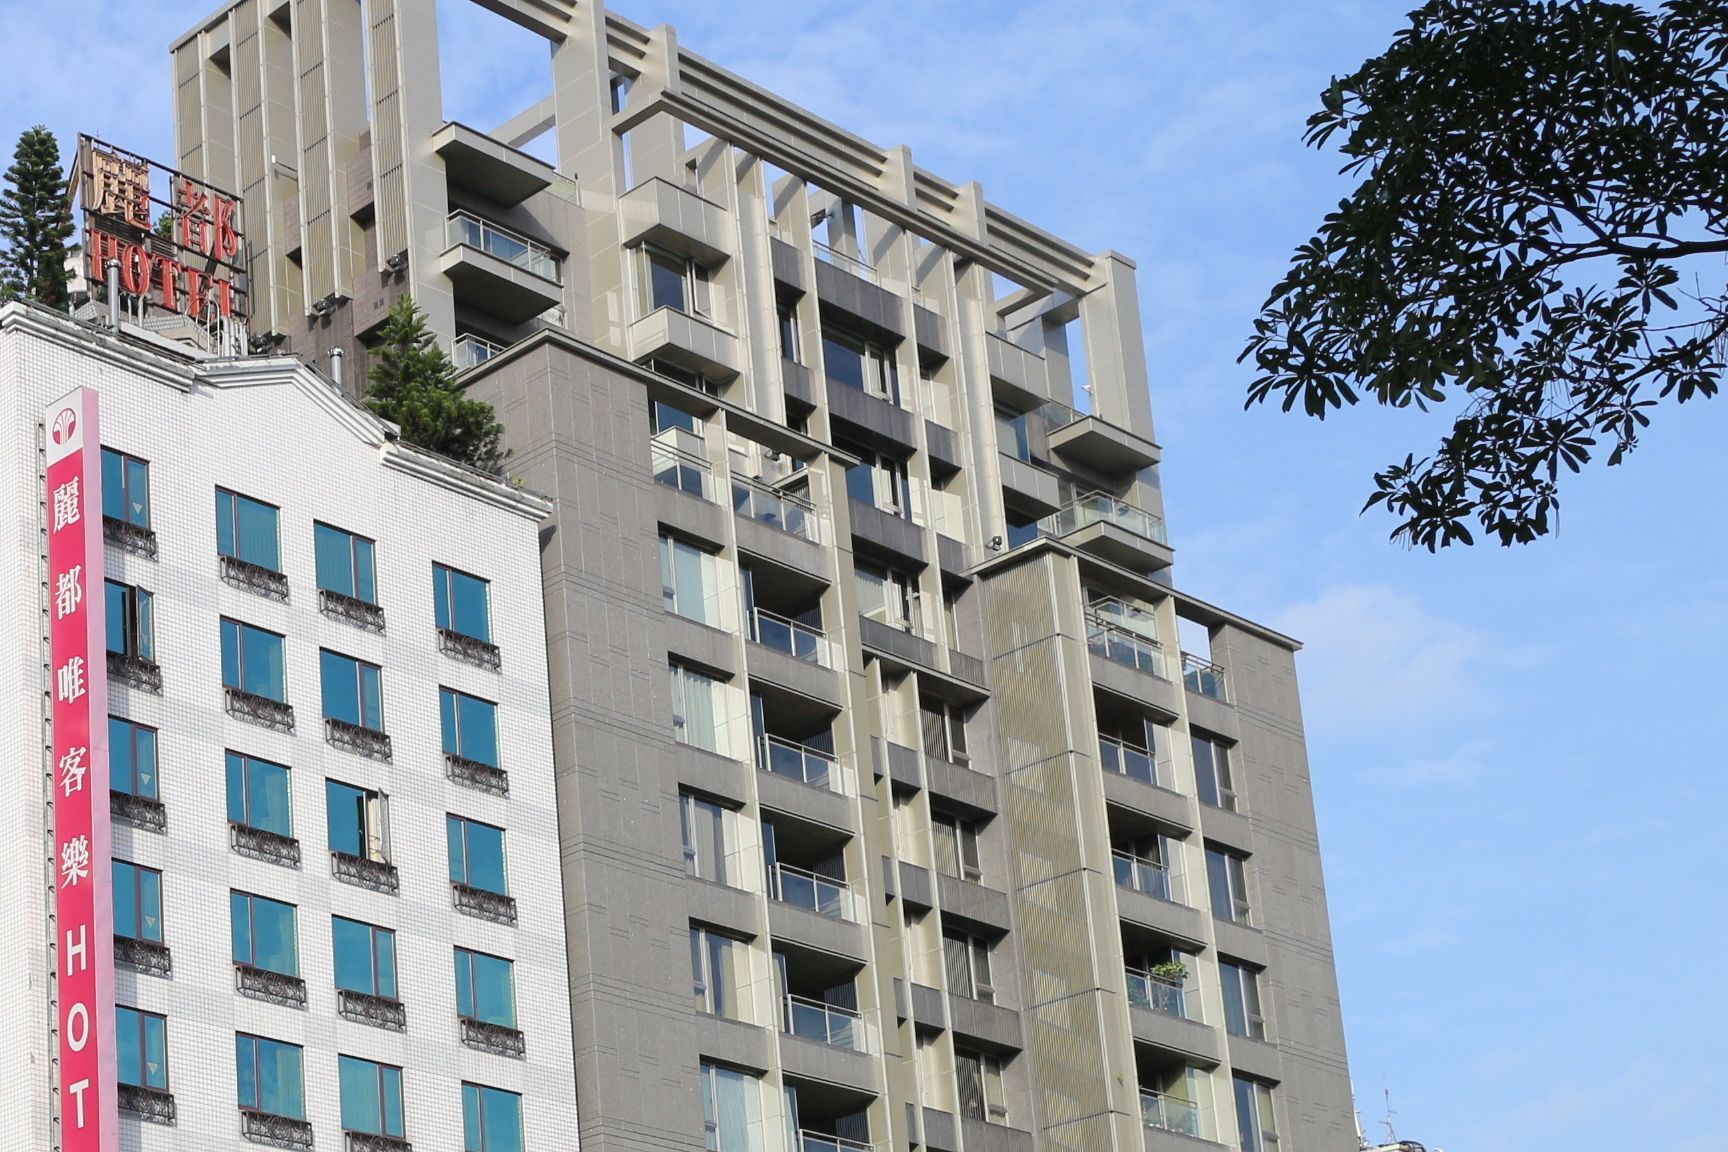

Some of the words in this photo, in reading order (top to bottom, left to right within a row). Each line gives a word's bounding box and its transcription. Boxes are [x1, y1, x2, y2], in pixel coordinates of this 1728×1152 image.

[92, 146, 239, 262] 麗都
[90, 228, 233, 318] HOTEL
[51, 474, 91, 890] 麗都唯客樂
